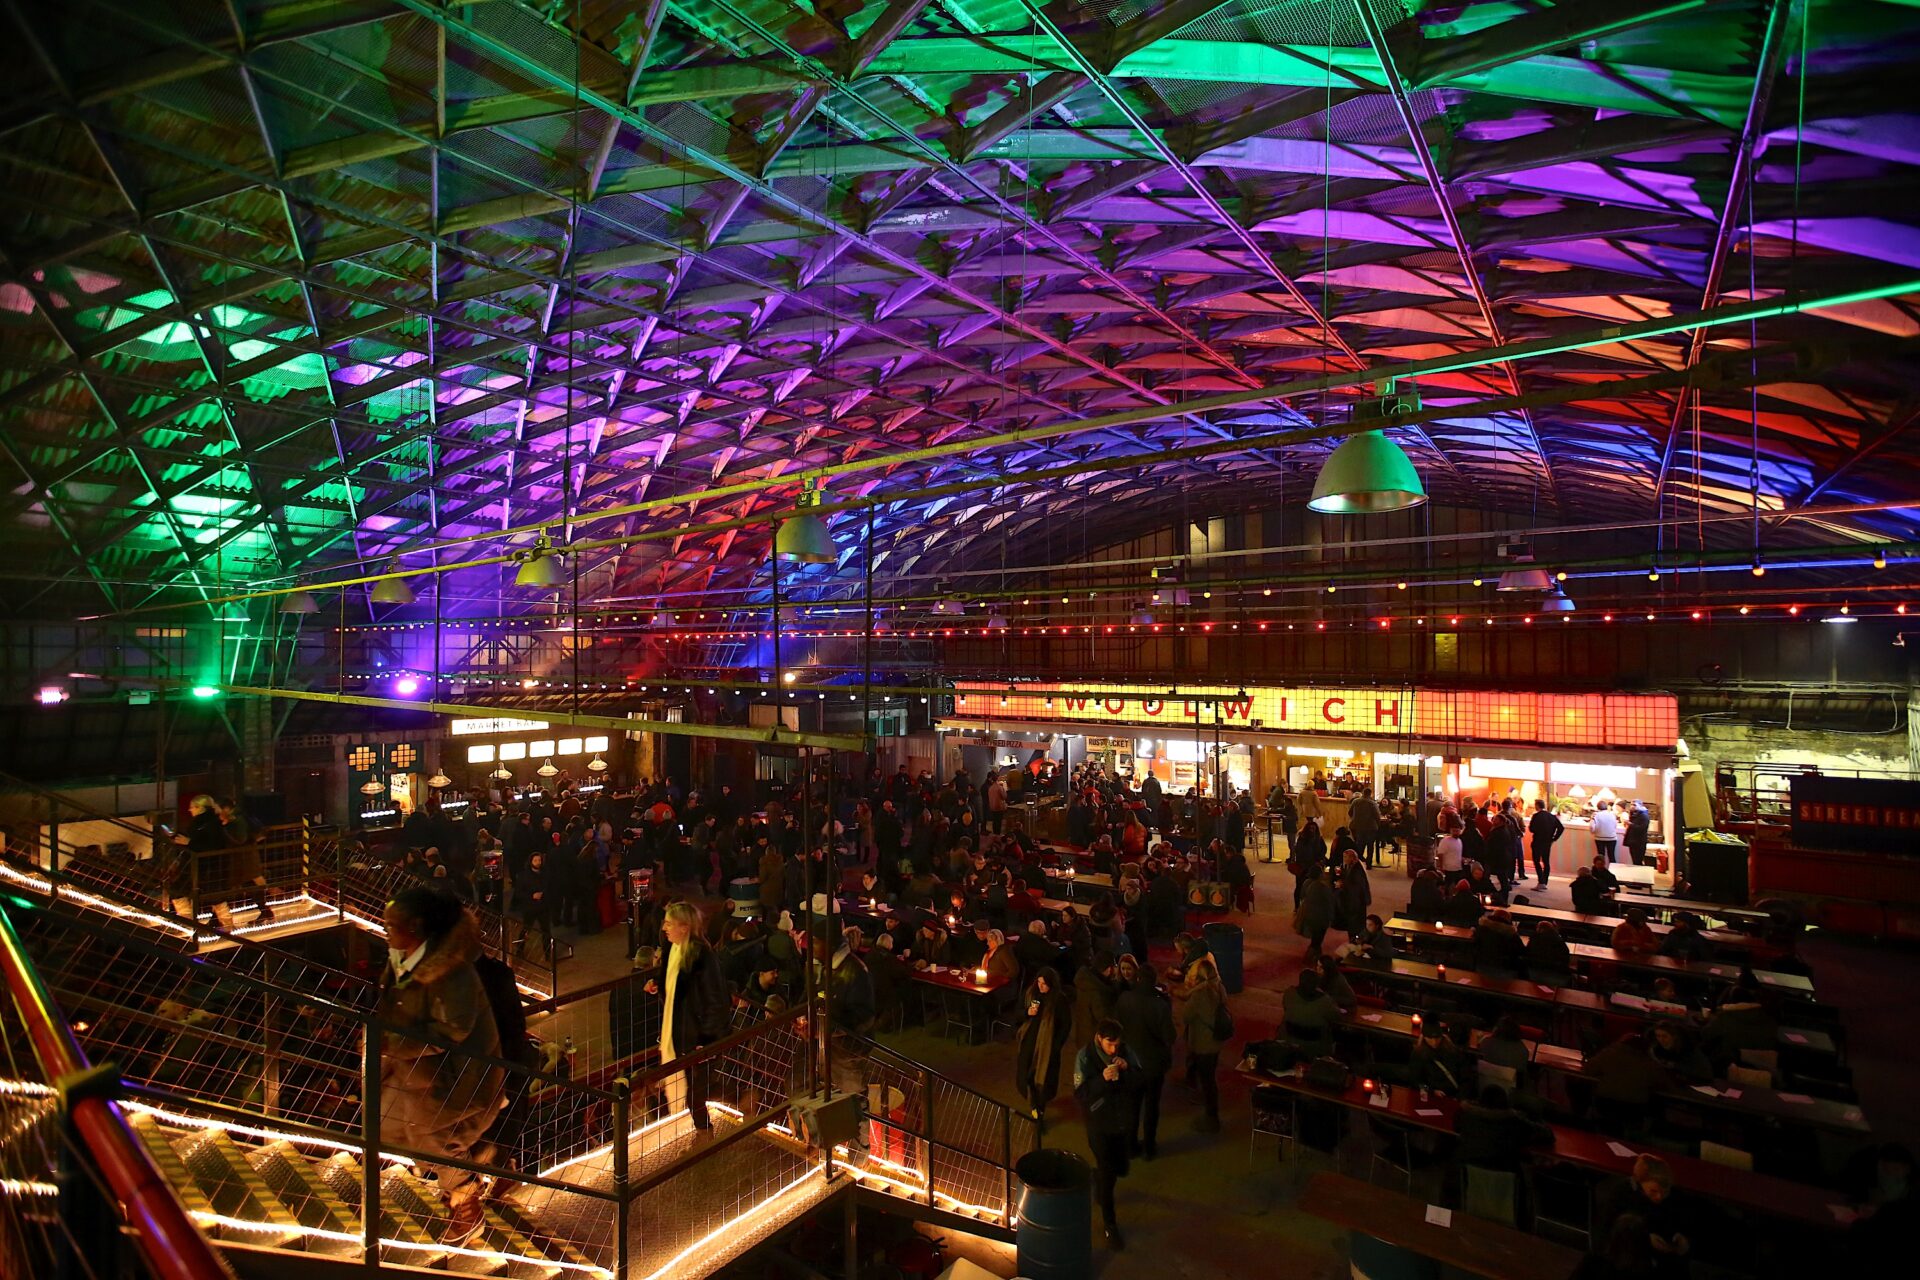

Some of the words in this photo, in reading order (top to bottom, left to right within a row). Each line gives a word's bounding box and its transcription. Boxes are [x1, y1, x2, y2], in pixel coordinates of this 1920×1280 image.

[1063, 689, 1398, 726] WOOLWICH
[1006, 740, 1024, 749] PIZZA
[1800, 803, 1876, 823] STREET
